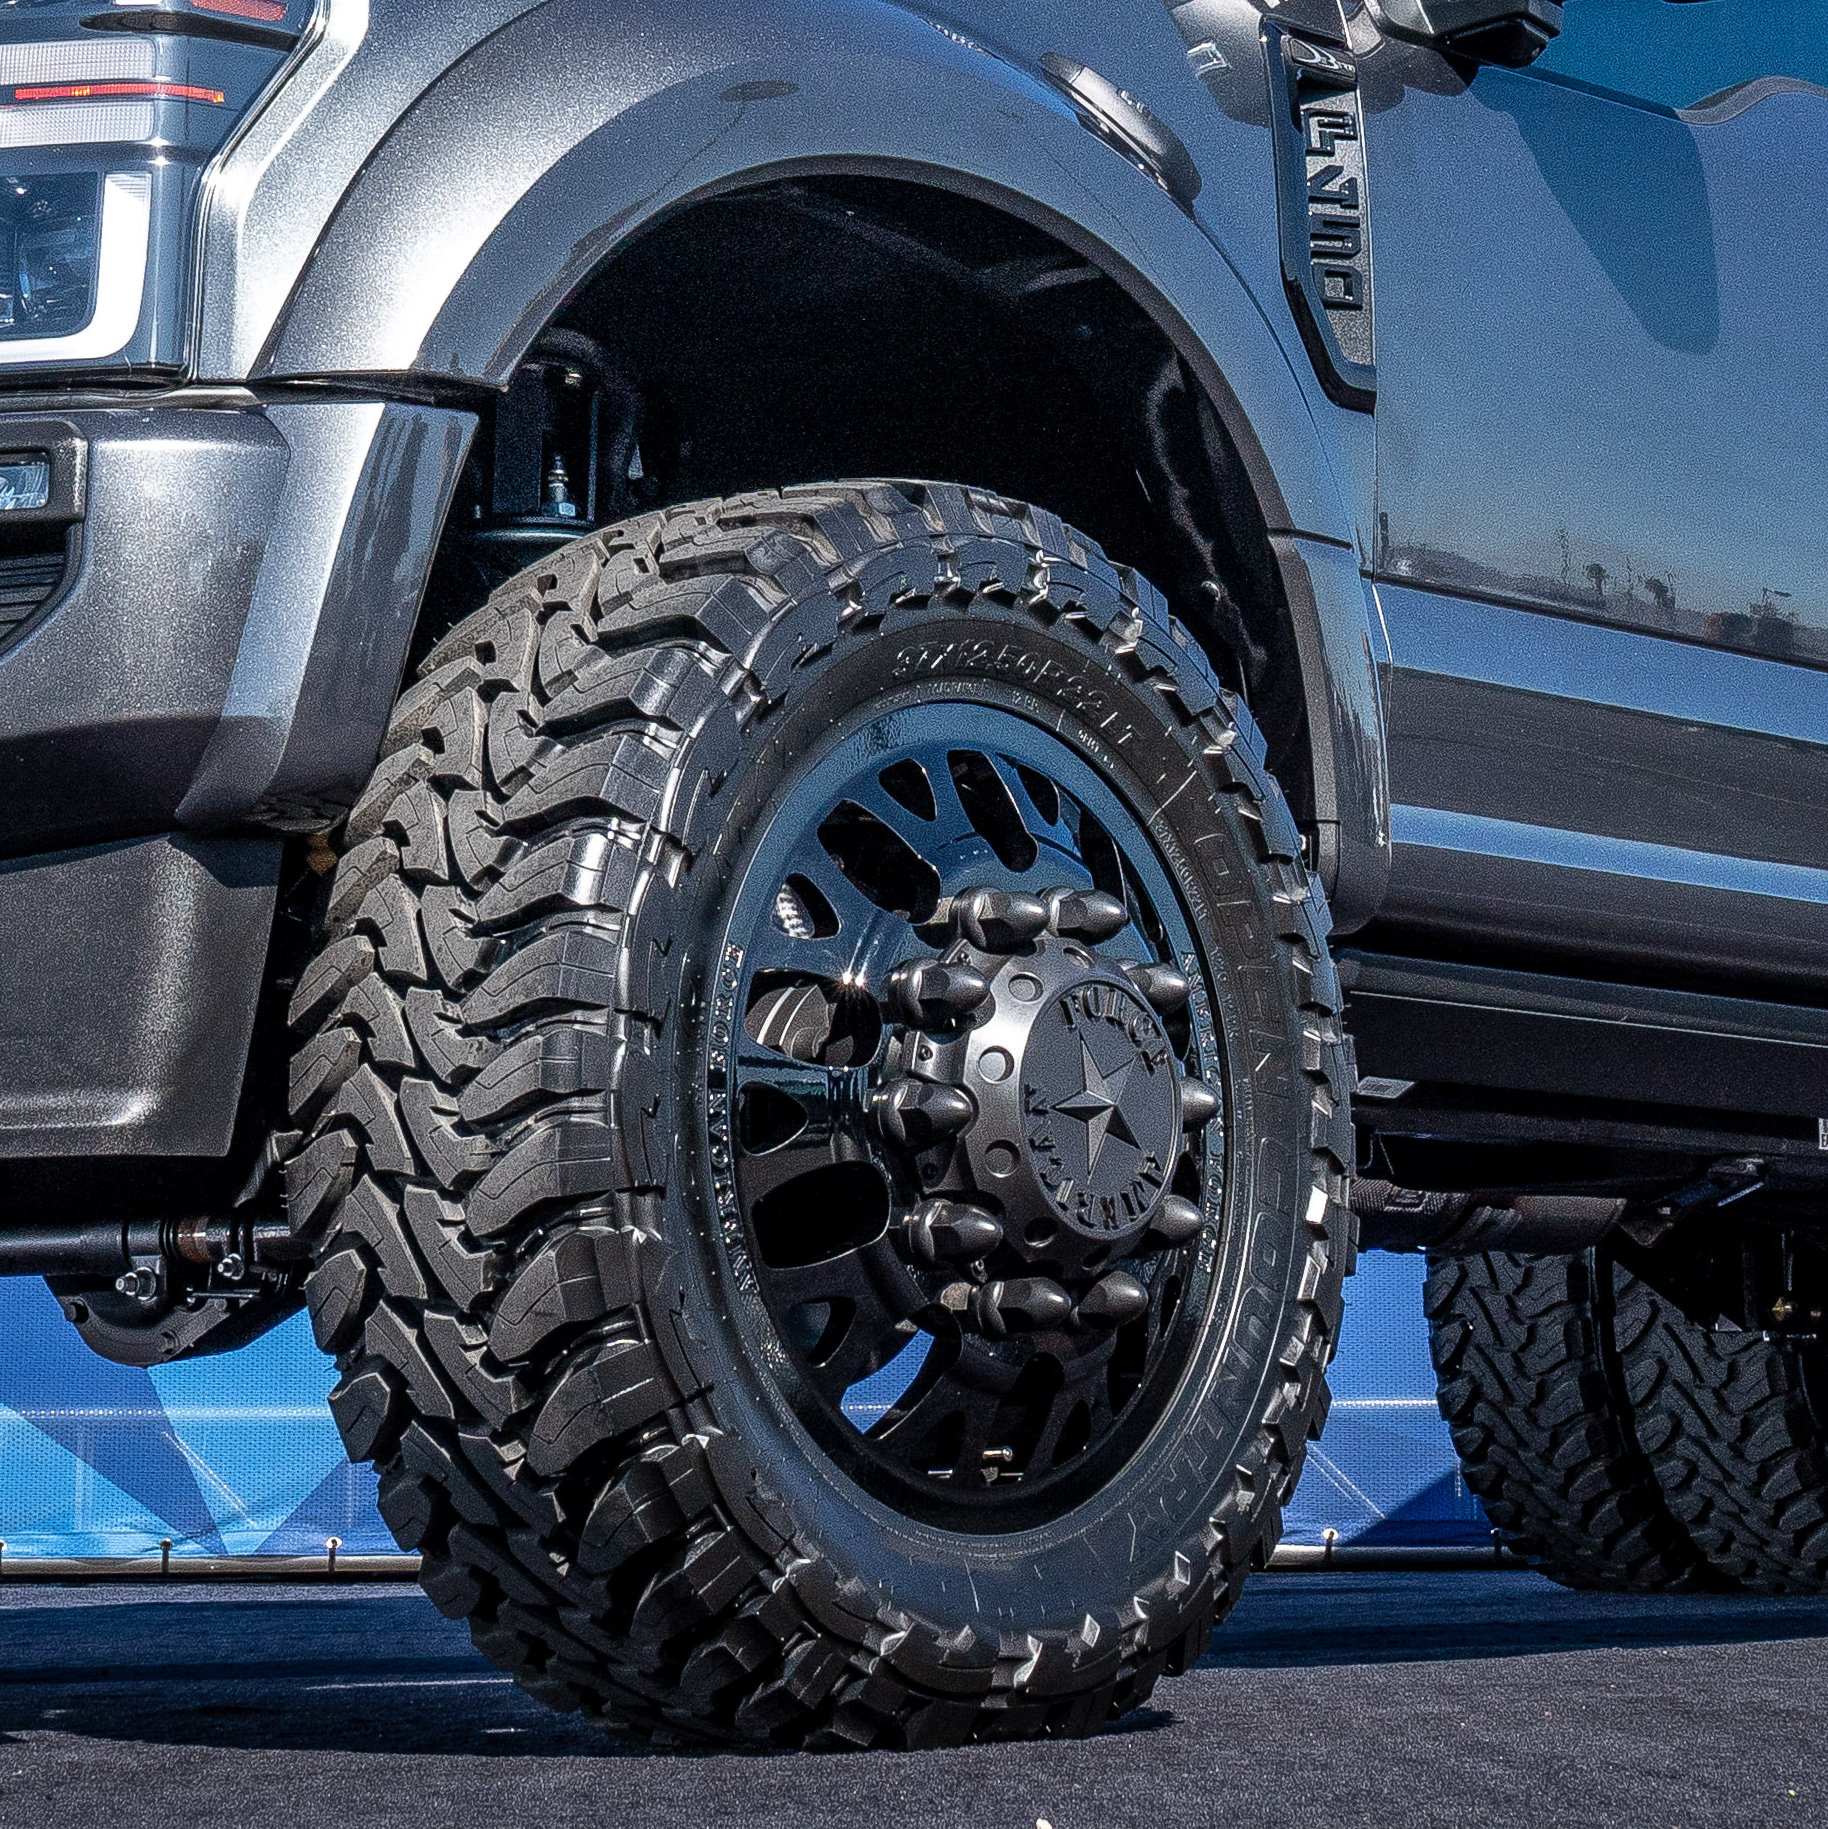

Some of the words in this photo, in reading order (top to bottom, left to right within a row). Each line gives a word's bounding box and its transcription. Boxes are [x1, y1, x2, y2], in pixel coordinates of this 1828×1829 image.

[708, 941, 745, 1071] FORCE
[1059, 986, 1167, 1074] FORCE
[1181, 950, 1224, 1139] AMERICN
[1025, 1084, 1162, 1230] AMERICAN
